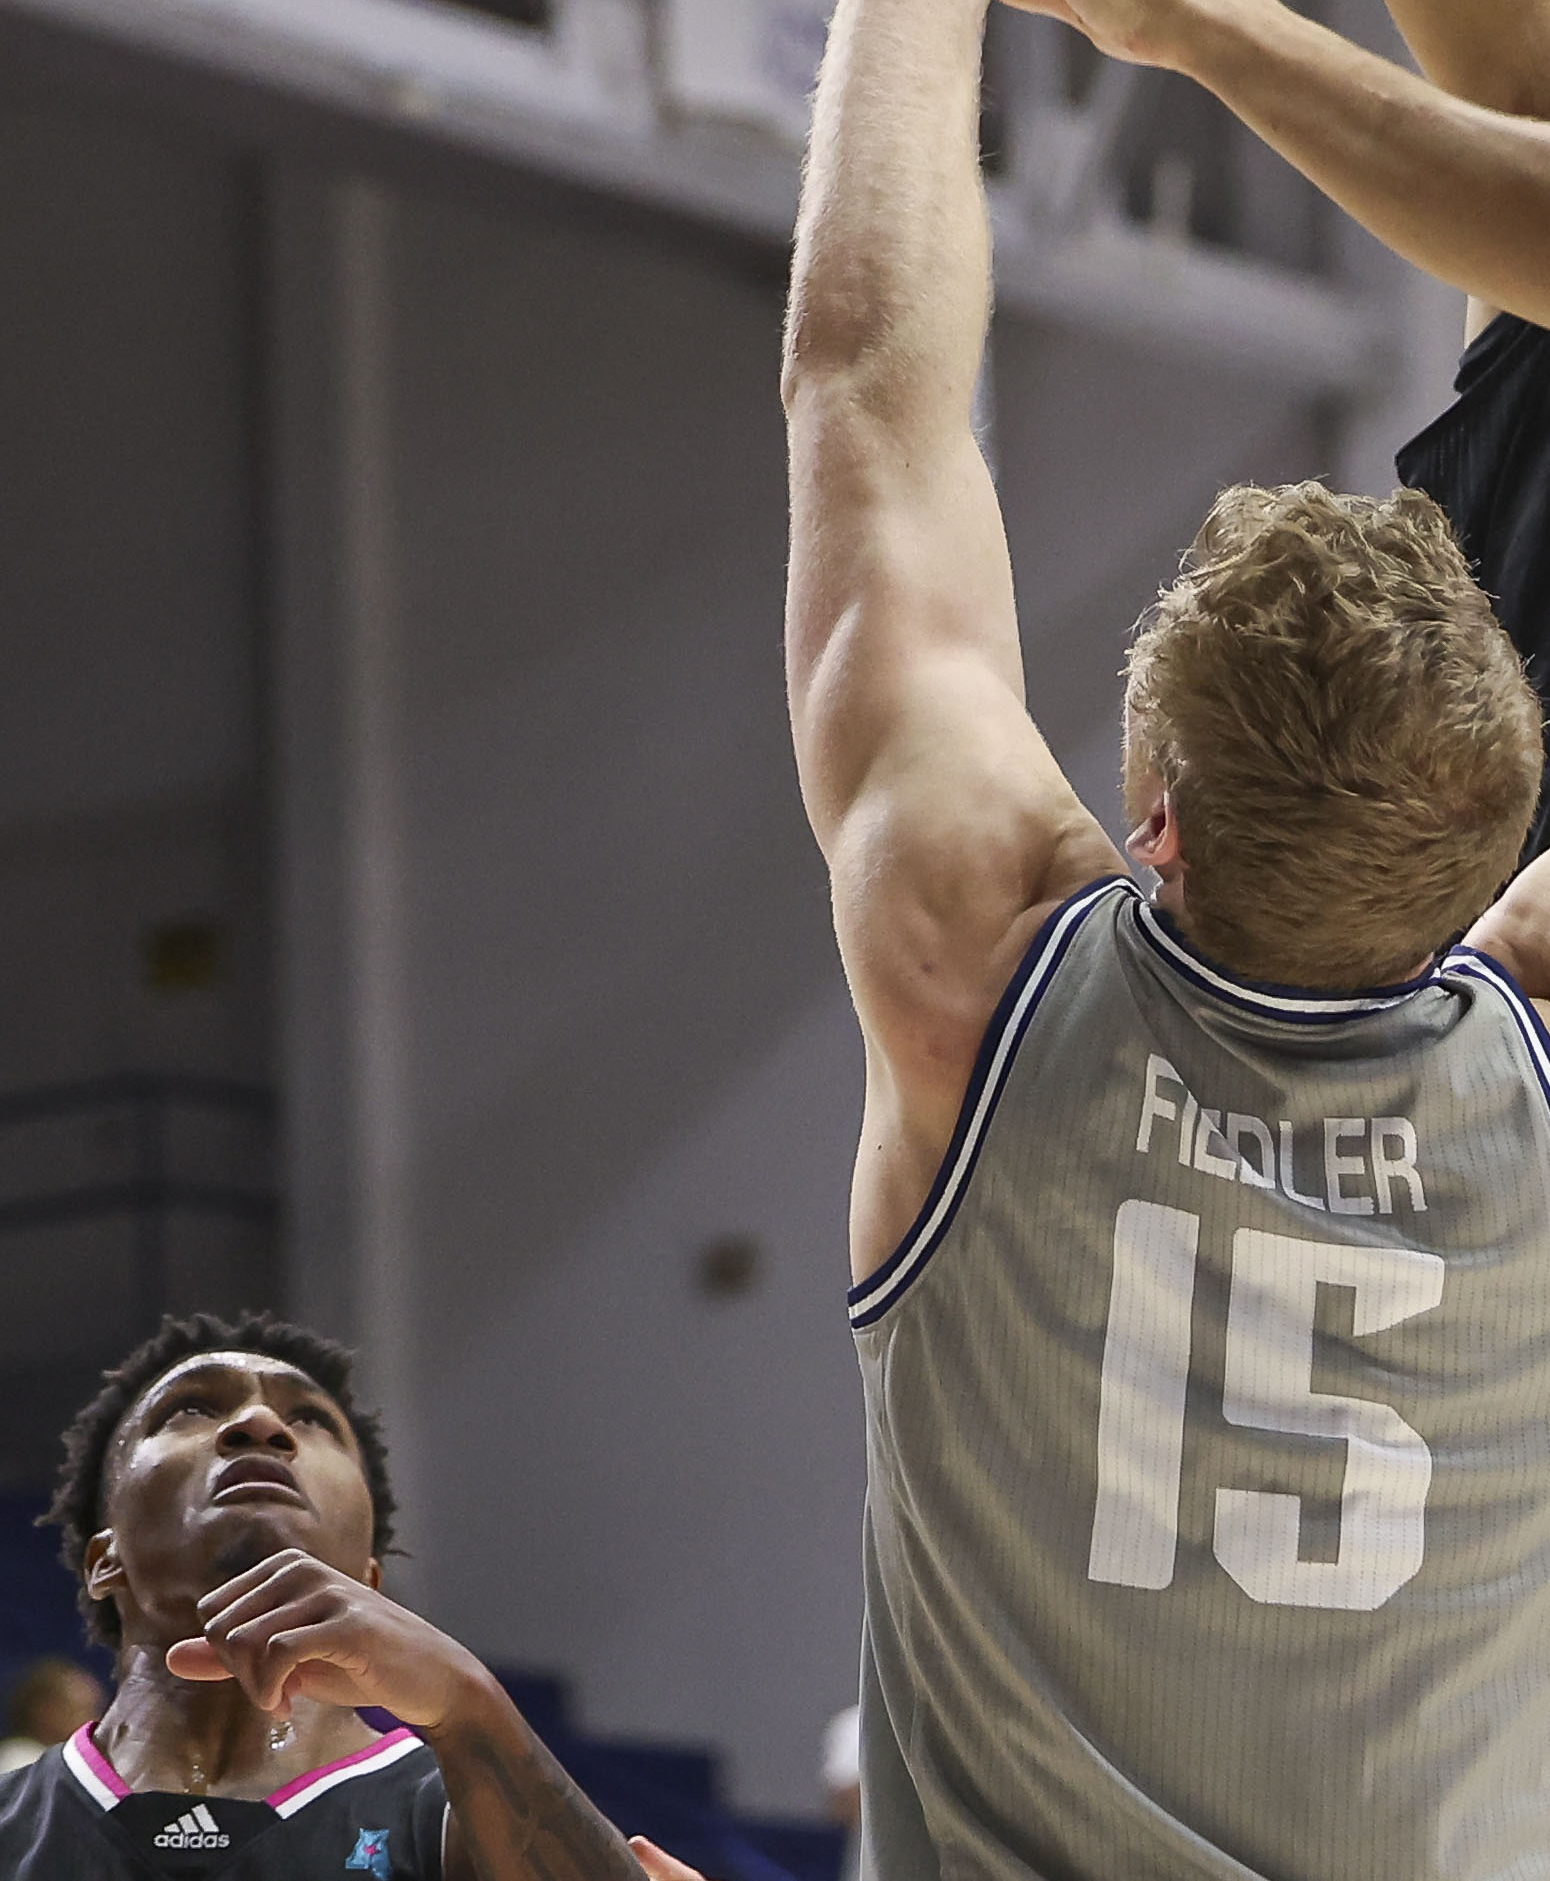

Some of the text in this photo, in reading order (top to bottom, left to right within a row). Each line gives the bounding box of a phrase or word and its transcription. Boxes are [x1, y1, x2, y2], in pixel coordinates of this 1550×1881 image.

[1136, 1053, 1428, 1215] FIEDLER
[1088, 1198, 1446, 1612] 15
[153, 1833, 230, 1849] adidas
